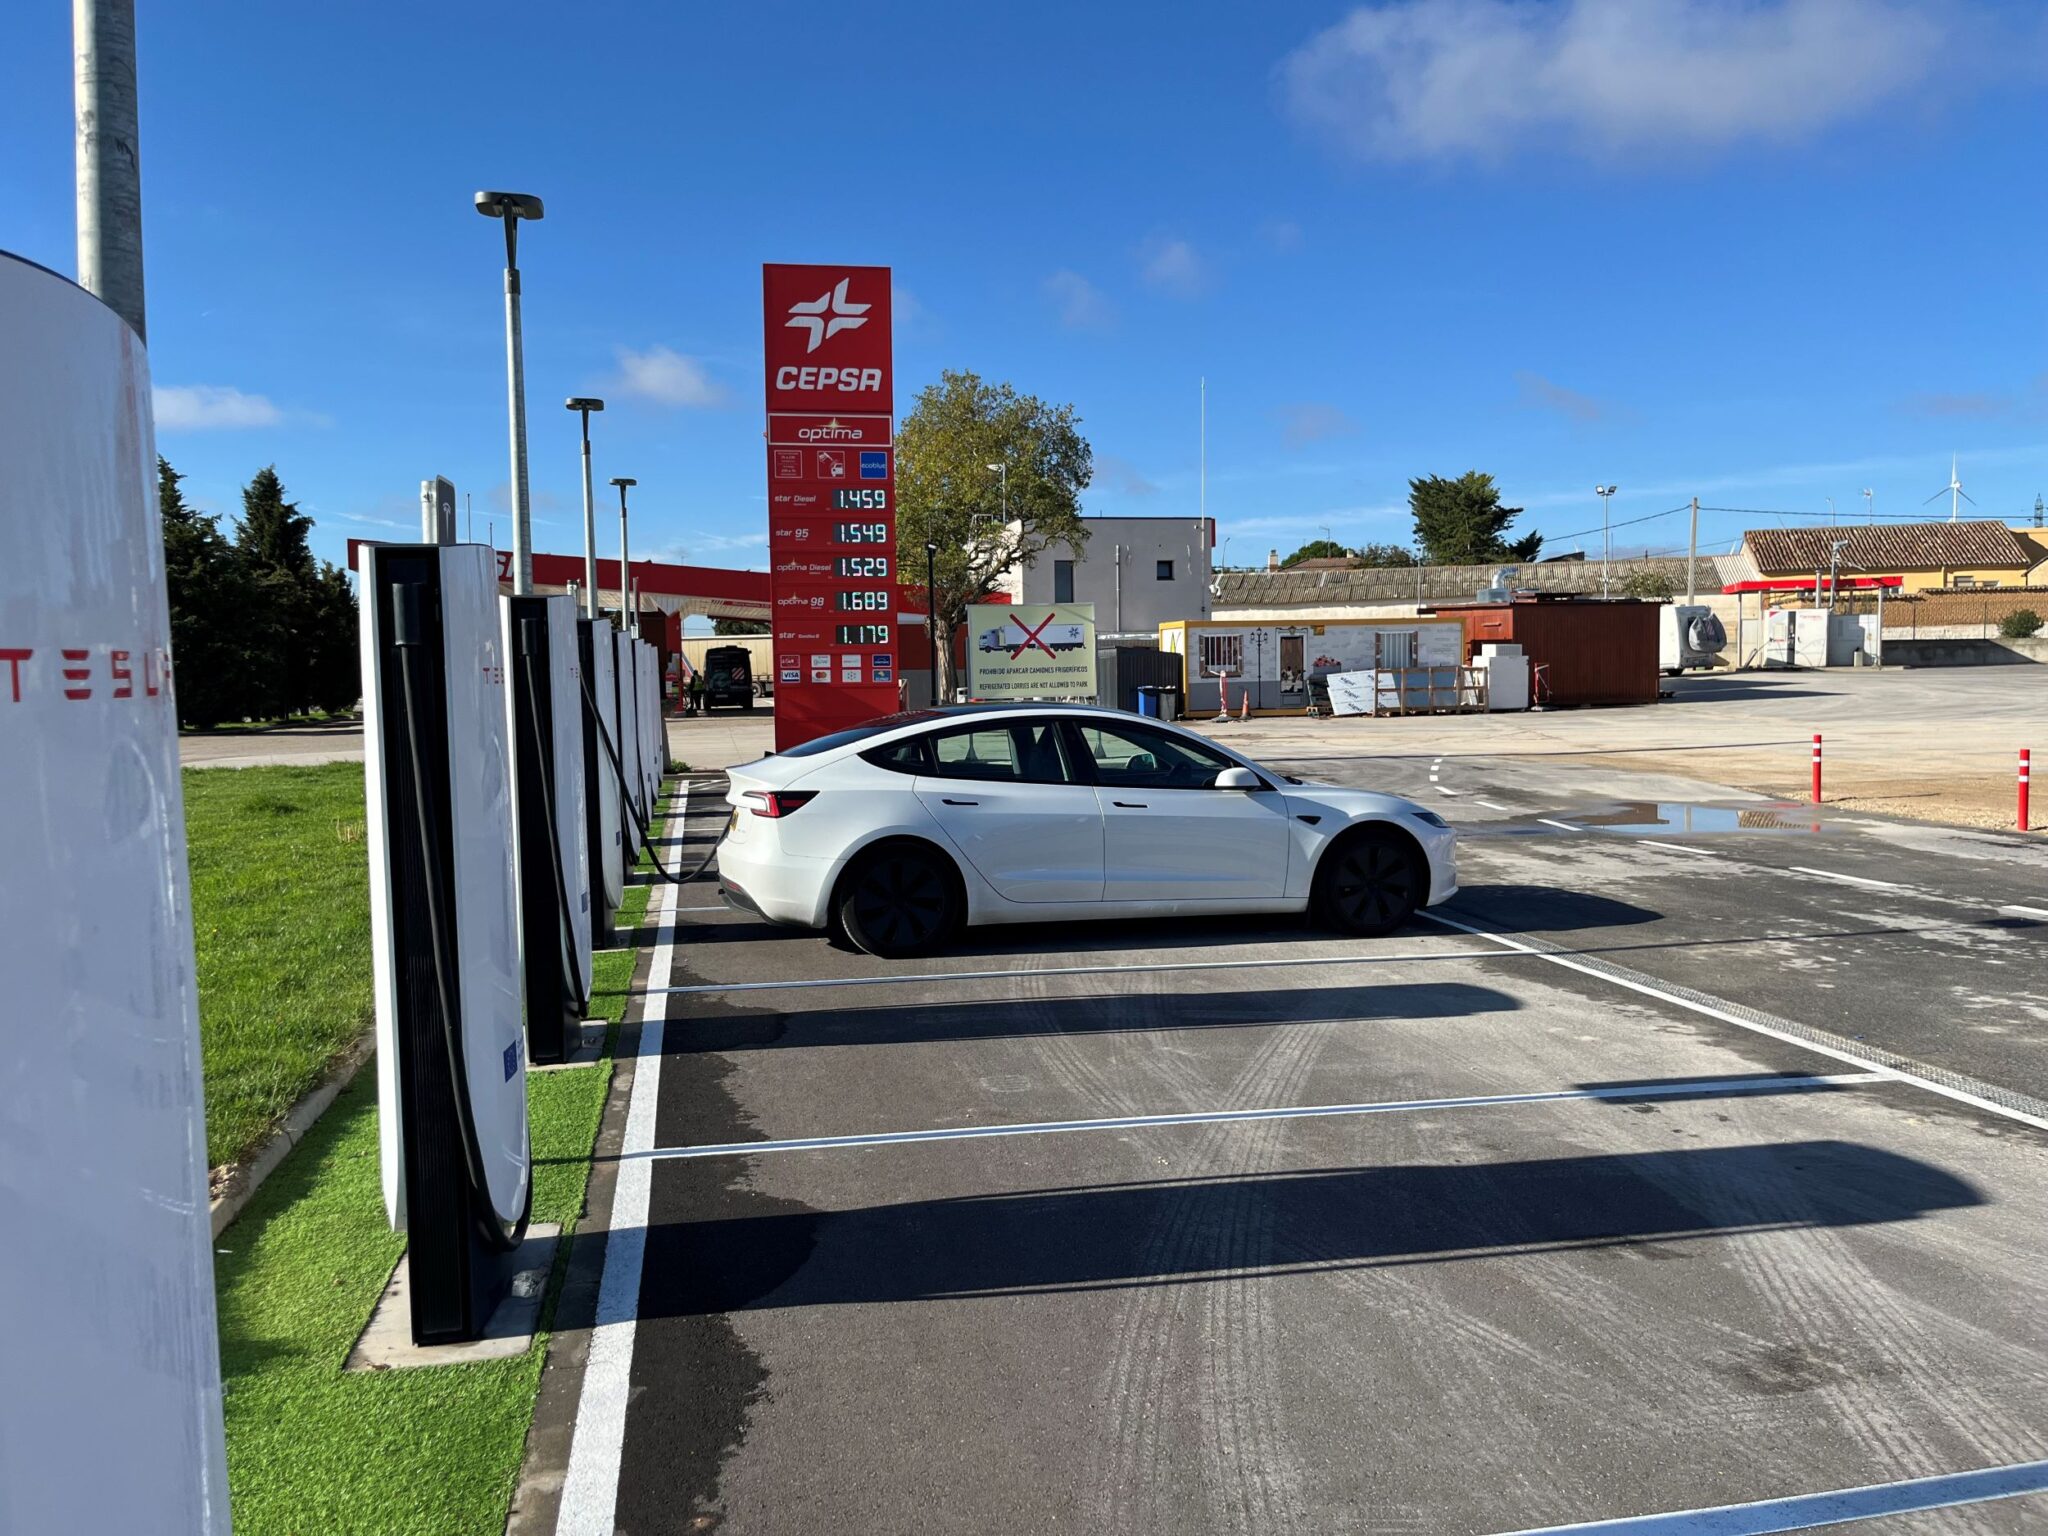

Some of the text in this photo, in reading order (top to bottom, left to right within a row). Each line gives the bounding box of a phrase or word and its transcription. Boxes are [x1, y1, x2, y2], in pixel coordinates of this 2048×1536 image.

[776, 366, 882, 391] CEPSA
[798, 423, 863, 443] optima
[840, 489, 886, 508] 1.459
[795, 528, 809, 538] 95
[841, 523, 887, 543] 1.549
[776, 557, 887, 577] optima Diesel 1.529
[777, 596, 808, 606] optima
[810, 597, 824, 606] 98
[843, 592, 888, 611] 1.689
[778, 631, 796, 639] star
[843, 625, 888, 644] 1.179
[1011, 682, 1030, 690] LORRIES
[1049, 681, 1069, 689] ALLOWED
